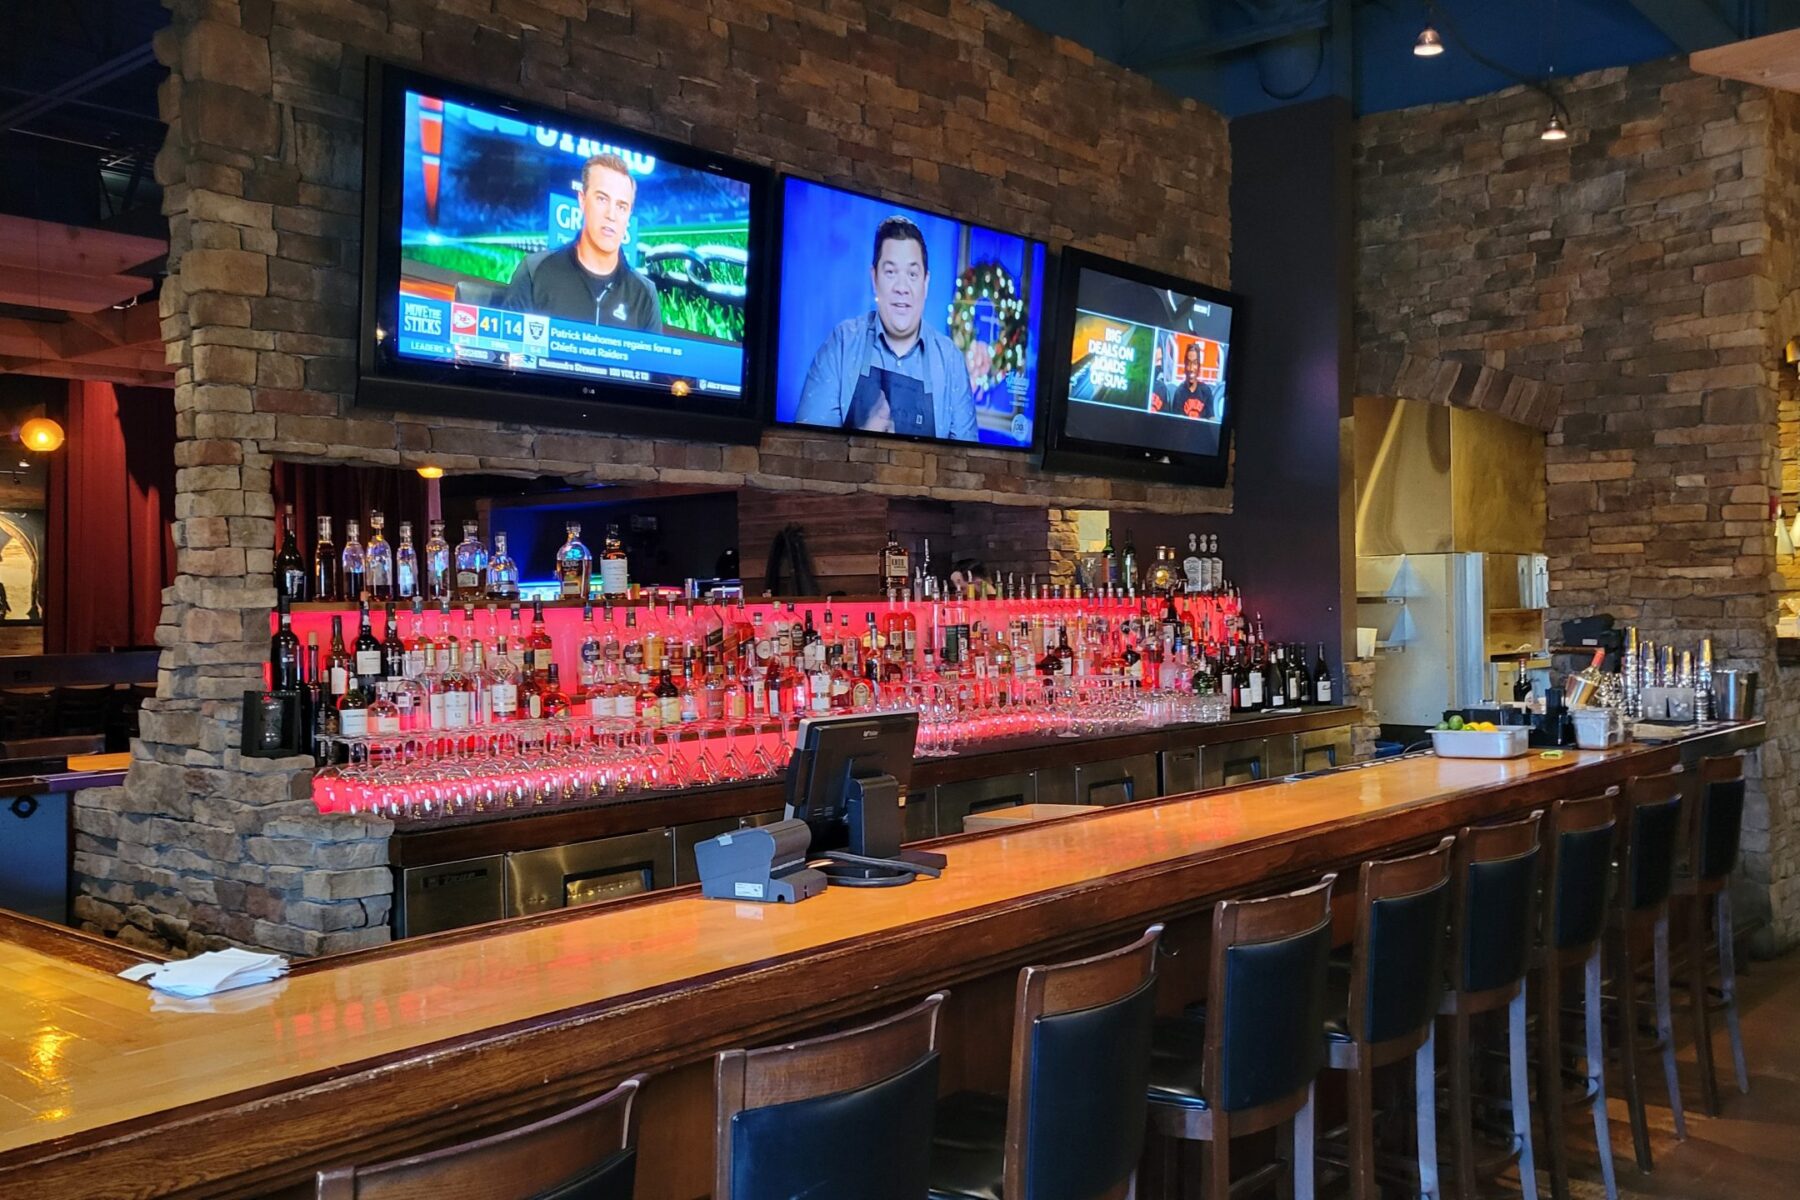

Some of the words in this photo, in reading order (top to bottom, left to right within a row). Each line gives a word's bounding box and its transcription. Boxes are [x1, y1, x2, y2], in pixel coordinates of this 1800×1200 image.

[404, 303, 428, 318] MOVE
[404, 316, 442, 336] STICKS
[480, 316, 499, 333] 41
[504, 320, 523, 336] 14
[1105, 327, 1122, 344] BIG
[550, 341, 578, 354] Chiefs
[579, 346, 596, 356] rout
[598, 348, 629, 361] Raiders
[551, 328, 581, 341] Patrick
[583, 333, 622, 347] Mahomes
[624, 341, 652, 351] regains
[653, 343, 672, 354] form
[673, 348, 682, 356] as
[1088, 338, 1119, 358] DEALS
[1118, 346, 1134, 362] ON
[1090, 370, 1105, 385] OF
